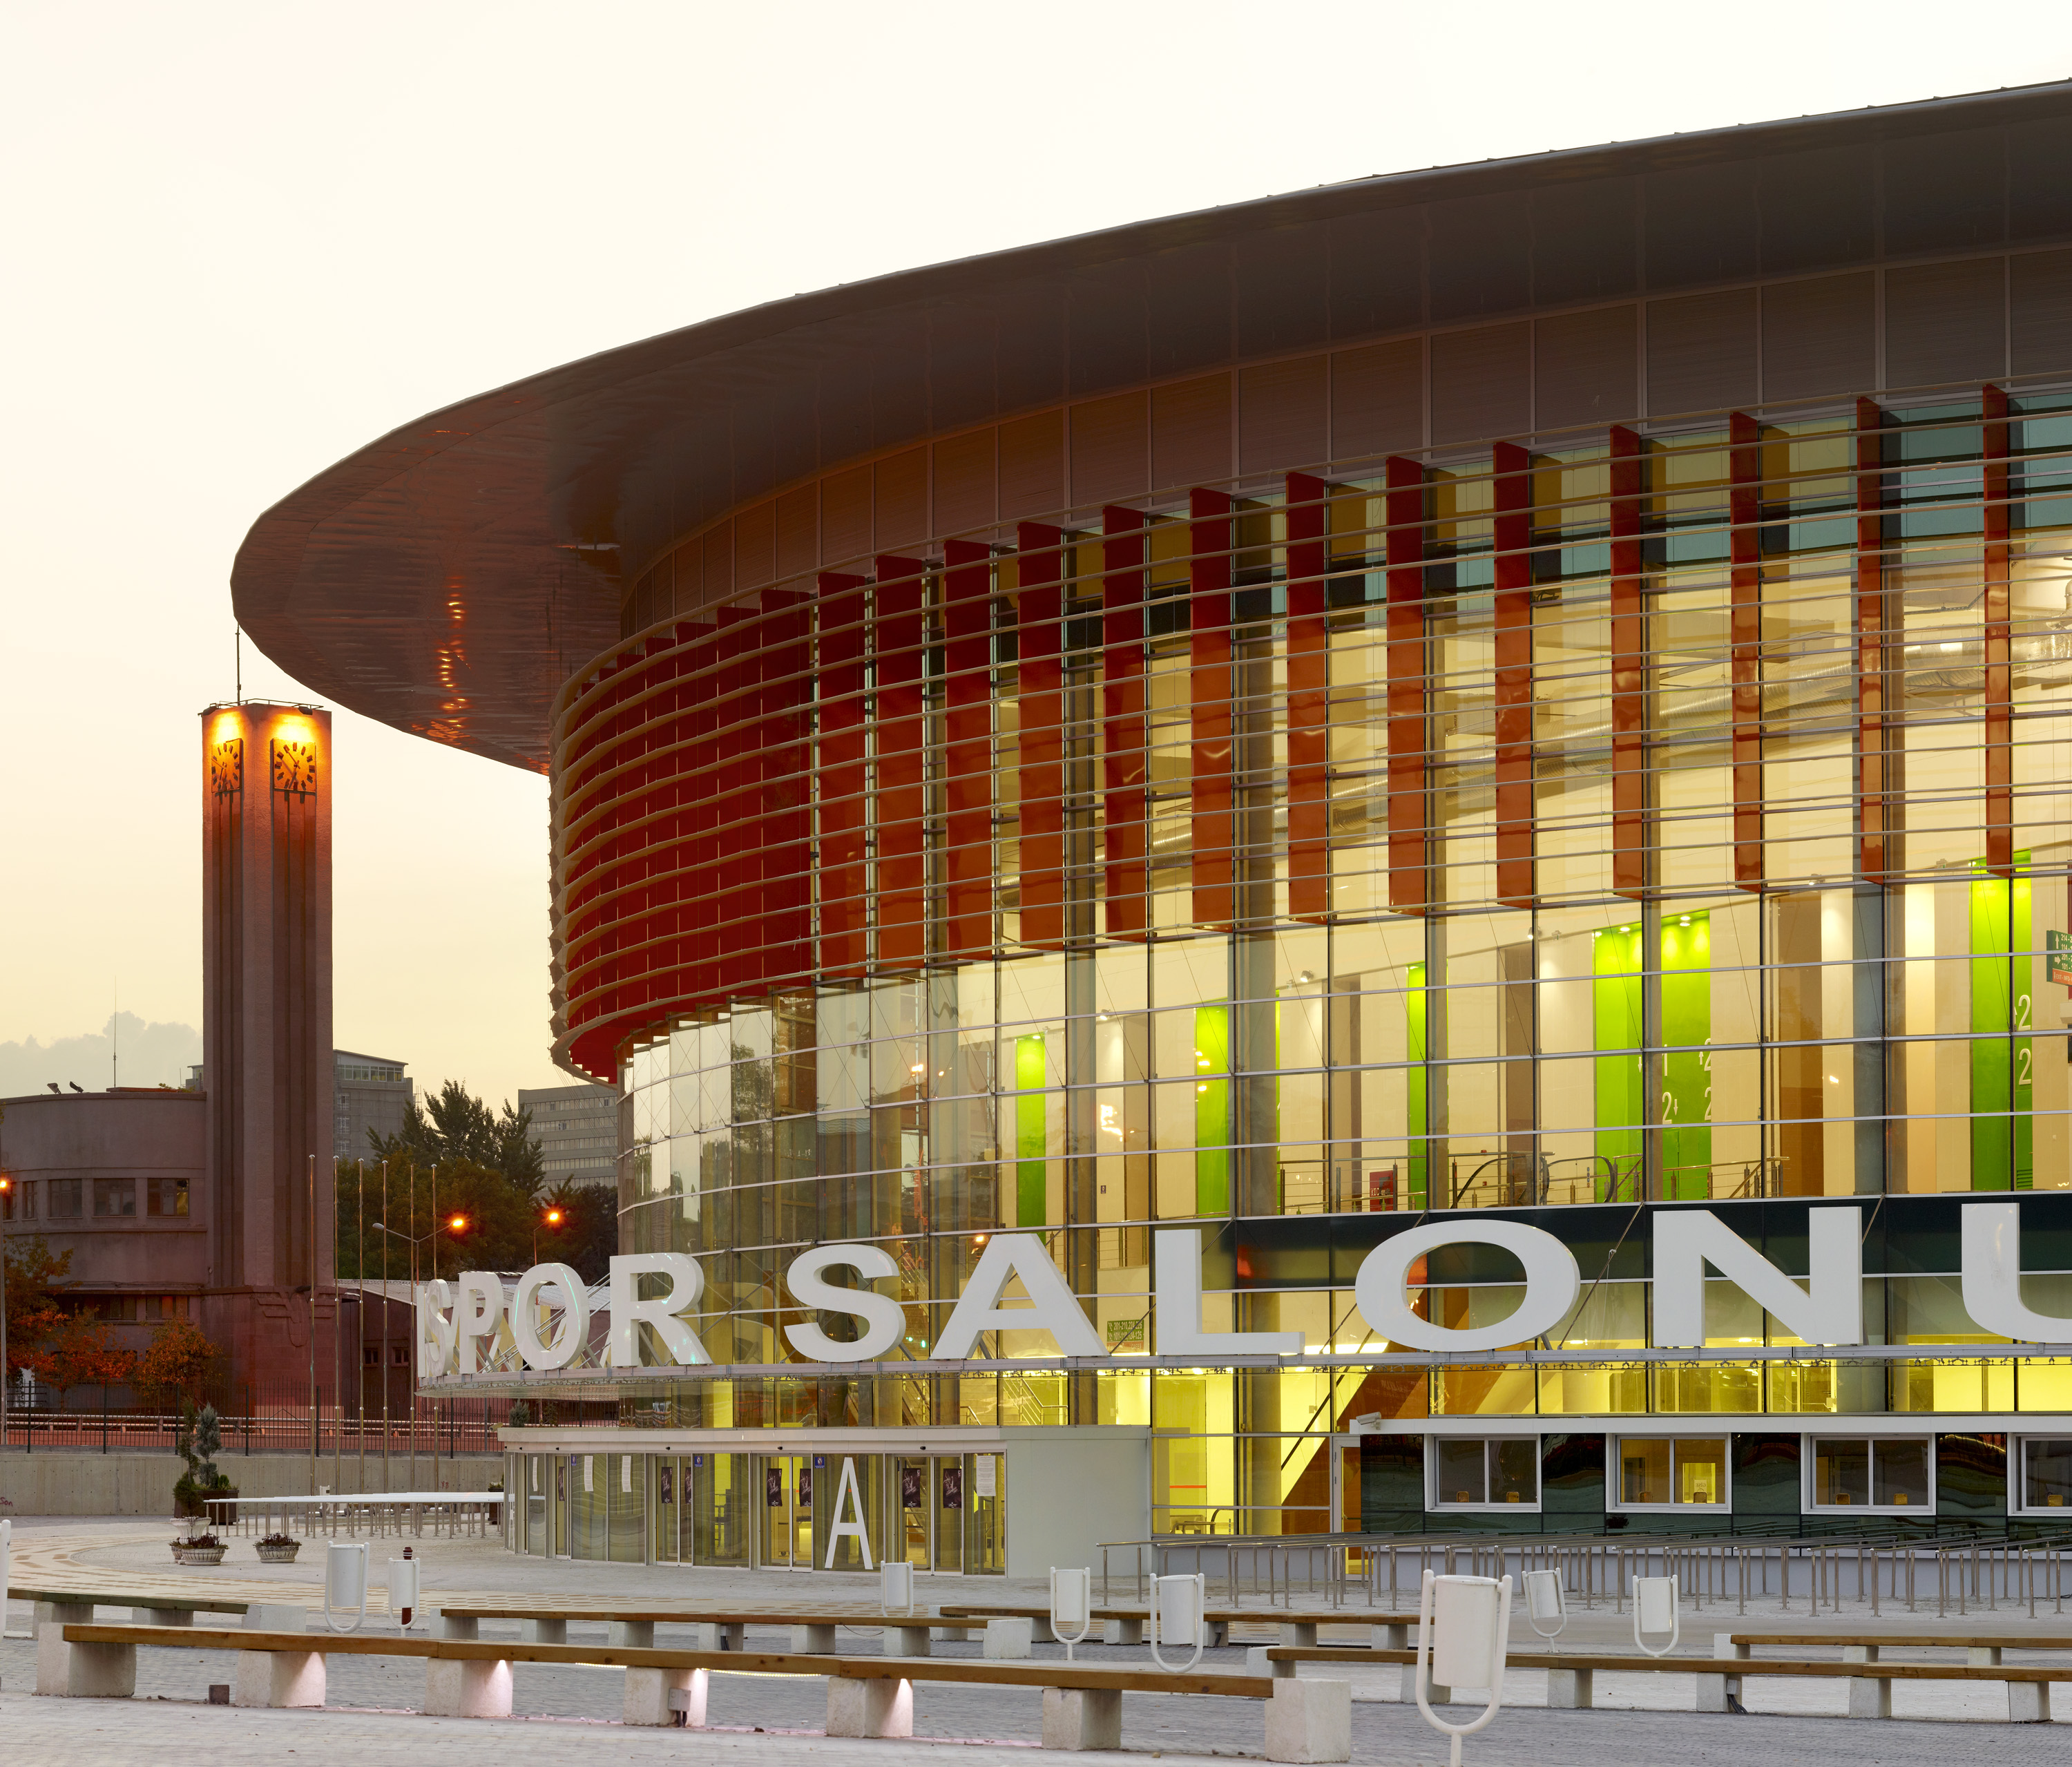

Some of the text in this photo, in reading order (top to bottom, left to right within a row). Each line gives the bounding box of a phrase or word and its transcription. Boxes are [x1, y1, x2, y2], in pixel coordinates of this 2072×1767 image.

[2018, 994, 2031, 1031] 2
[2019, 1048, 2032, 1085] 2
[1662, 1091, 1672, 1125] 2
[424, 1252, 714, 1377] SPOR
[824, 1457, 874, 1570] A
